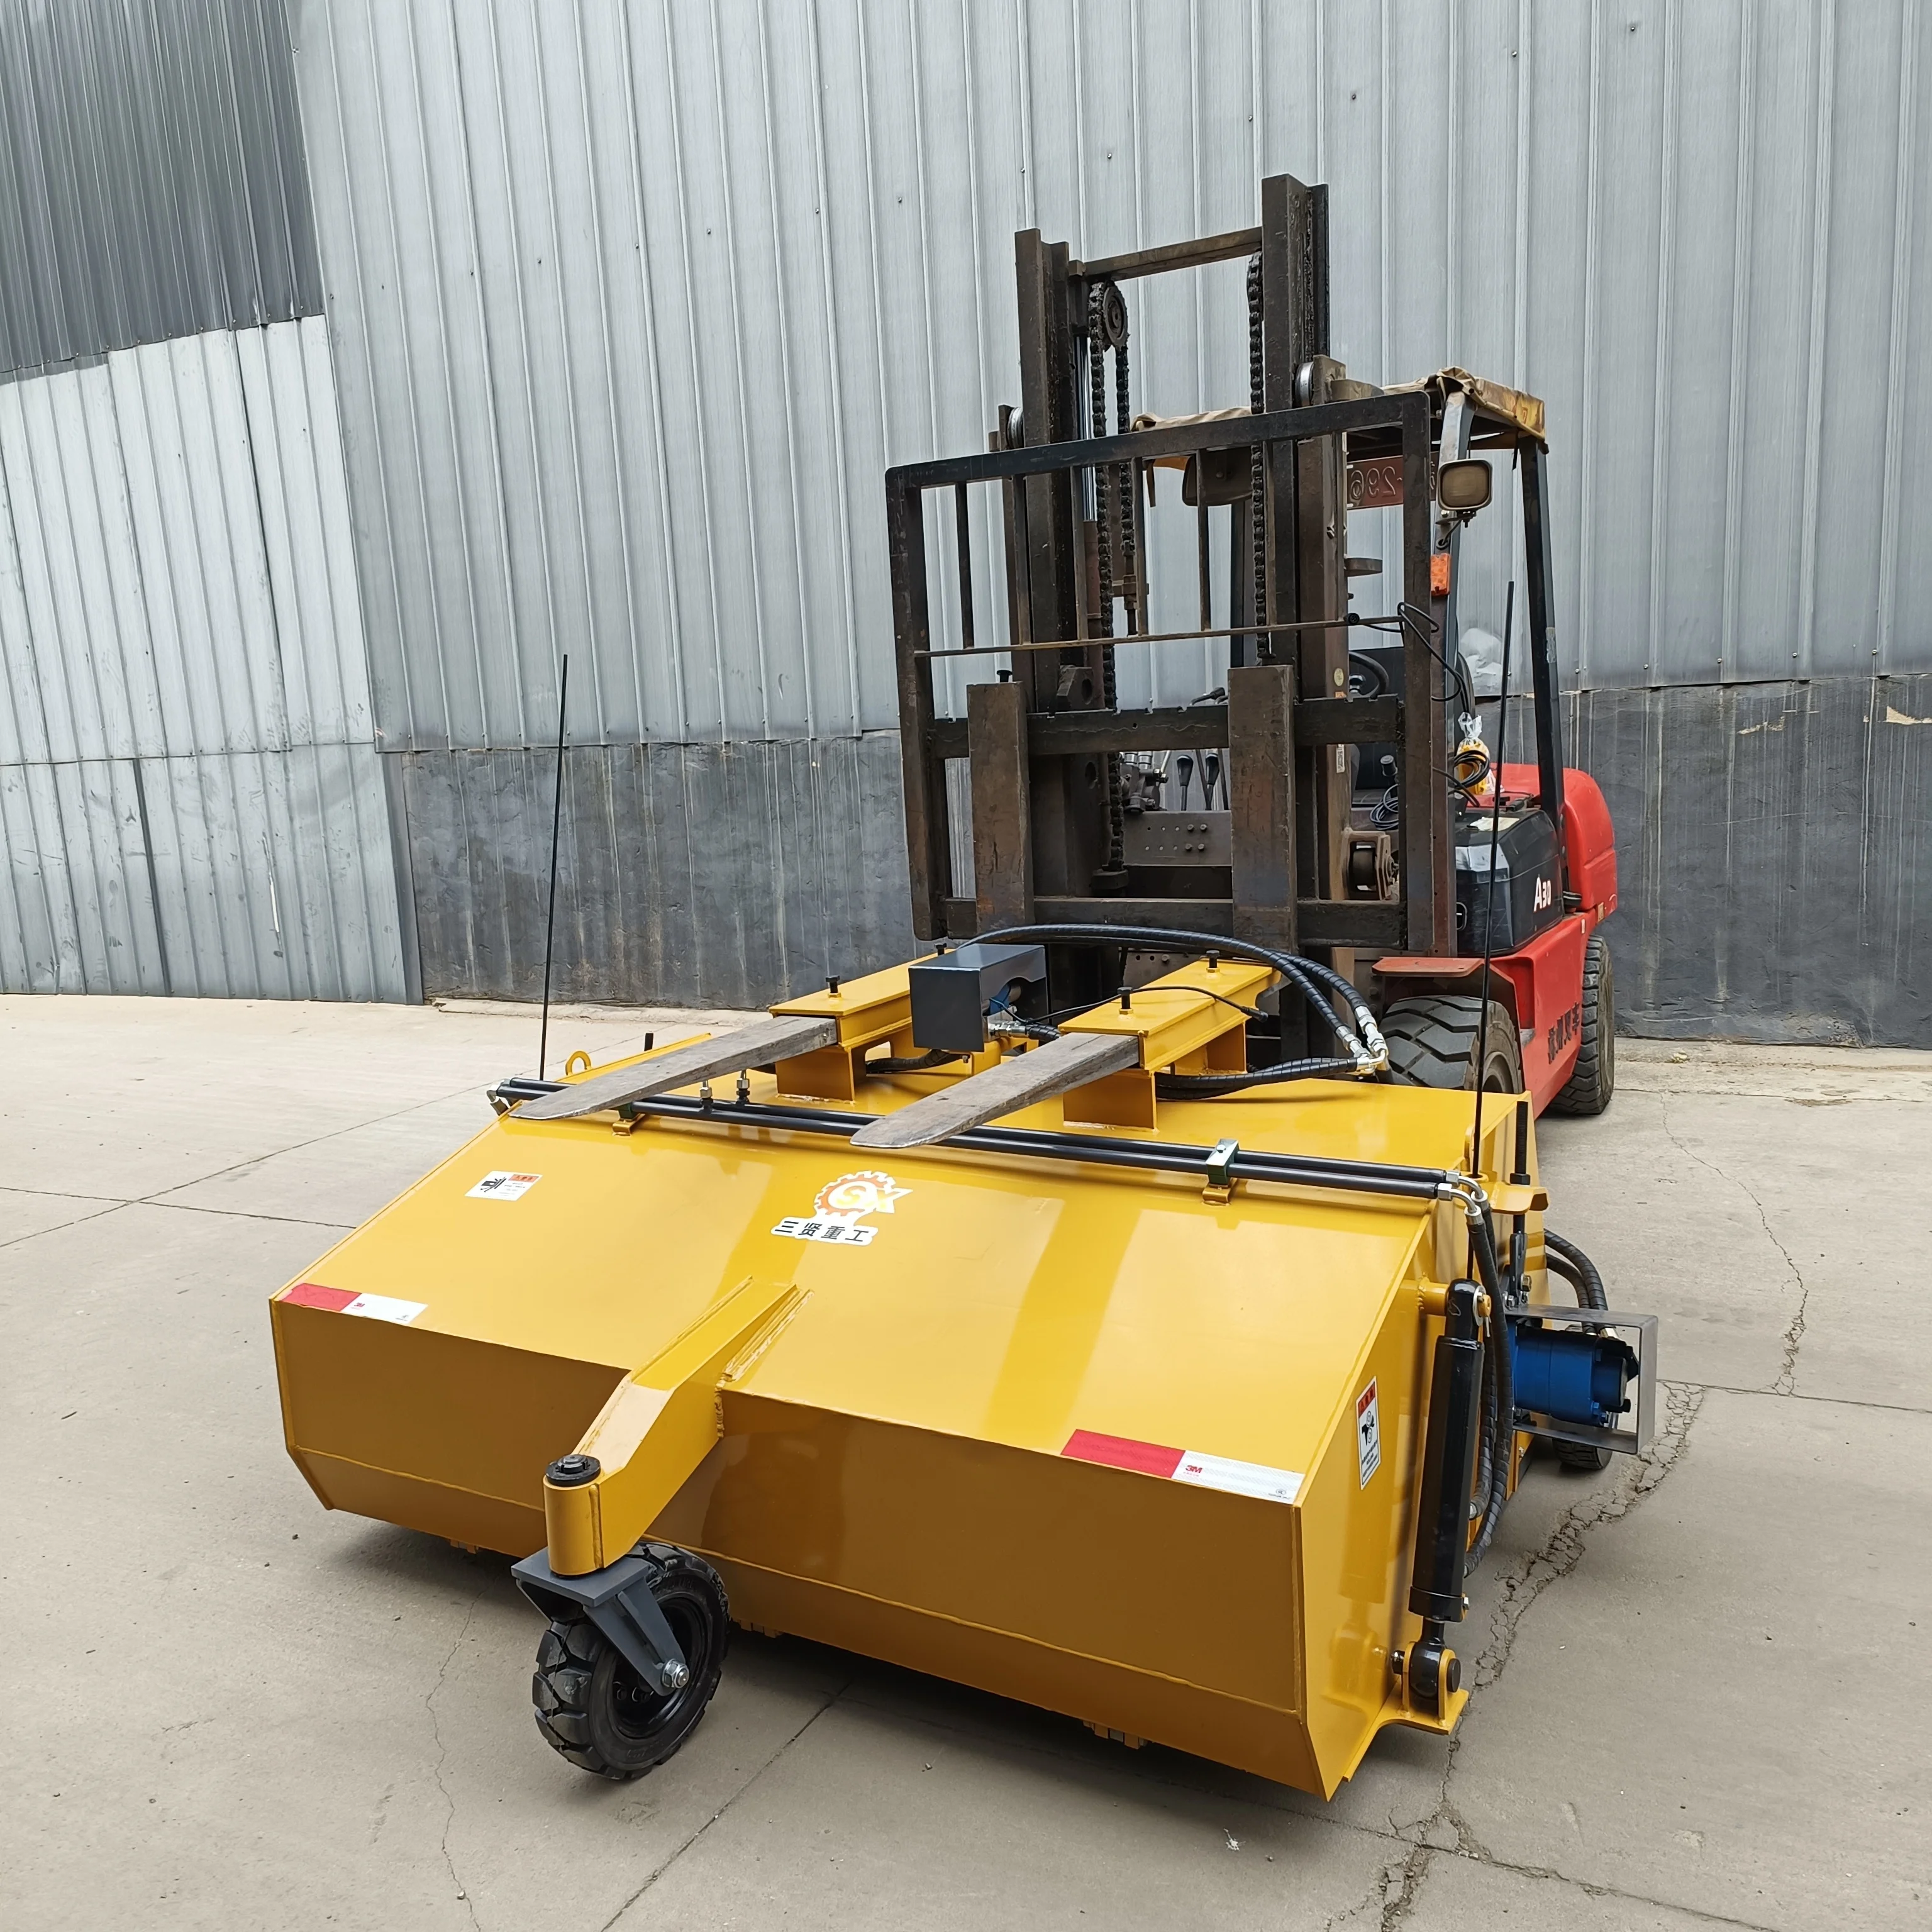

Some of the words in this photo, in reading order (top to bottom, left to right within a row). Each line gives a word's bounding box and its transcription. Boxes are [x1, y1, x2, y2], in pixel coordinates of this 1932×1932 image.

[1533, 875, 1552, 913] A30
[774, 1221, 870, 1243] 三贤重工
[1185, 1465, 1202, 1473] 3M
